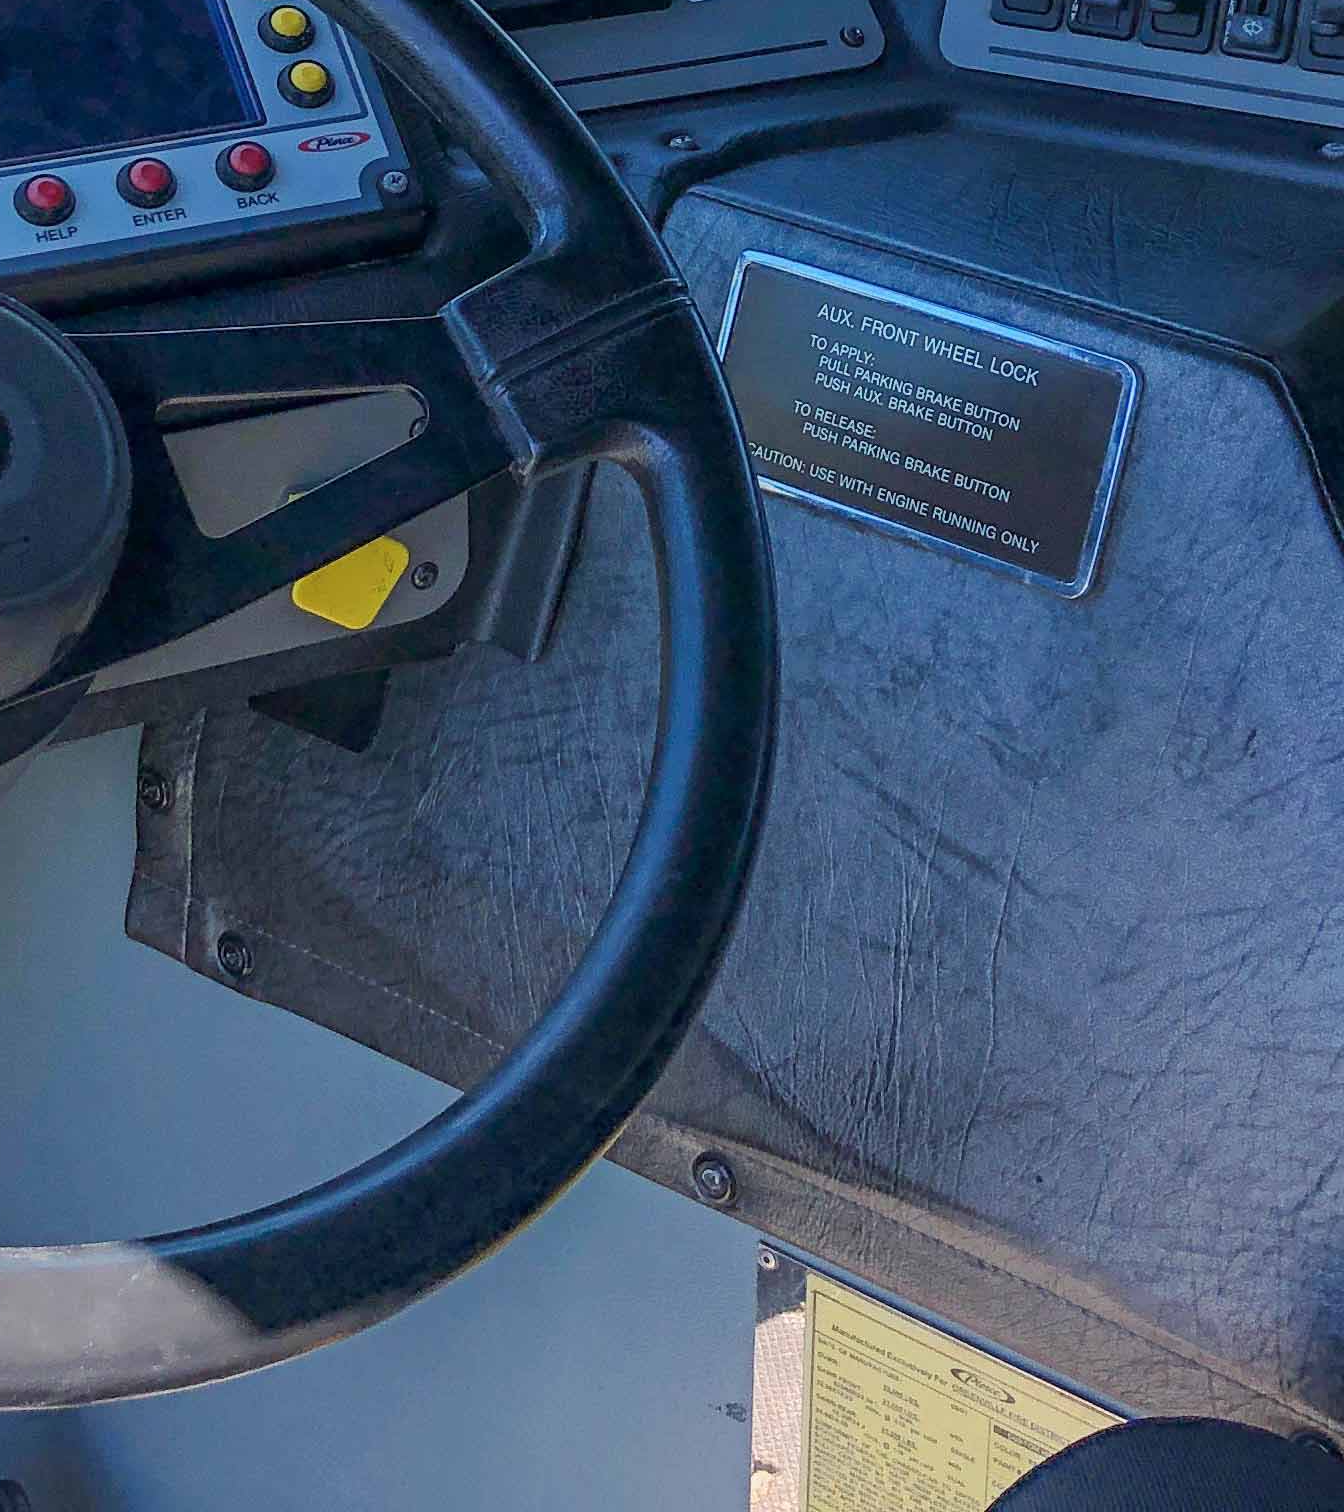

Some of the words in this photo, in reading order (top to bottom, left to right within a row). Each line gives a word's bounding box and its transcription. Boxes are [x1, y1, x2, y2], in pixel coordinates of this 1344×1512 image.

[132, 207, 188, 228] ENTER
[236, 191, 281, 209] BACK
[35, 226, 79, 244] HELP
[810, 334, 828, 350] TO
[830, 342, 876, 367] APPLY:
[817, 303, 855, 328] AUX.
[860, 316, 920, 347] FRONT
[924, 335, 984, 369] WHEEL
[990, 356, 1040, 386] LOCK
[793, 400, 812, 417] TO
[814, 407, 877, 439] RELEASE:
[815, 372, 850, 395] PUSH
[854, 386, 884, 406] AUX.
[888, 397, 933, 423] BRAKE
[937, 411, 994, 441] BUTTON
[819, 355, 851, 378] PULL
[854, 367, 913, 396] PARKING
[916, 387, 961, 413] BRAKE
[964, 400, 1022, 431] BUTTON
[802, 422, 838, 445] PUSH
[841, 435, 900, 466] PARKING
[904, 456, 950, 483] BRAKE
[954, 473, 1011, 504] BUTTON
[809, 463, 836, 485] USE
[839, 473, 874, 497] WITH
[876, 488, 930, 517] ENGINE
[932, 506, 997, 541] RUNNING
[1000, 530, 1040, 555] ONLY
